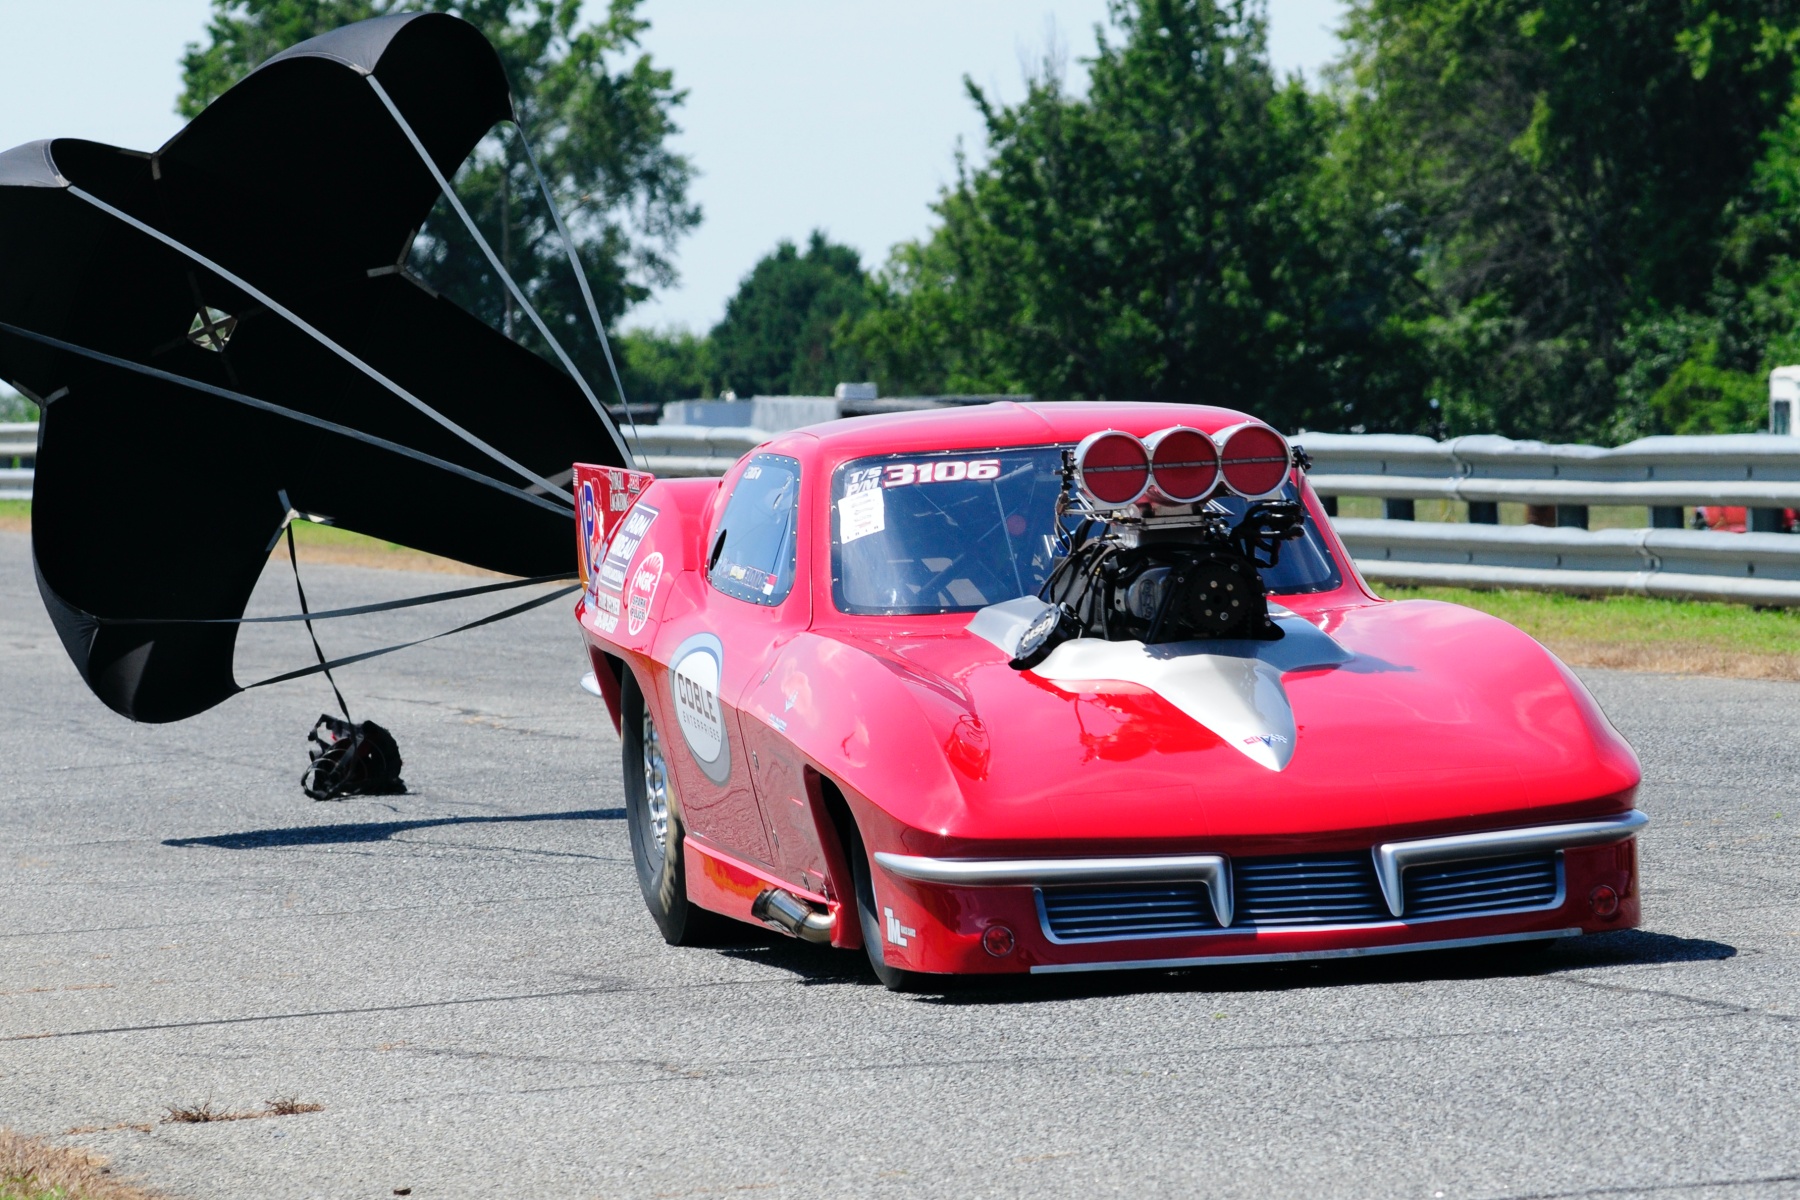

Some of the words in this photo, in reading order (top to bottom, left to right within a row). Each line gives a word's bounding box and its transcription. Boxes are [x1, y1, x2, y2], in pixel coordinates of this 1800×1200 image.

[849, 466, 883, 484] T/S
[882, 459, 1001, 489] 3106
[624, 512, 651, 538] FARM
[635, 570, 657, 593] NGK
[632, 594, 648, 608] SPARK
[677, 672, 718, 724] COBLE
[682, 709, 721, 743] ENTERPRISES
